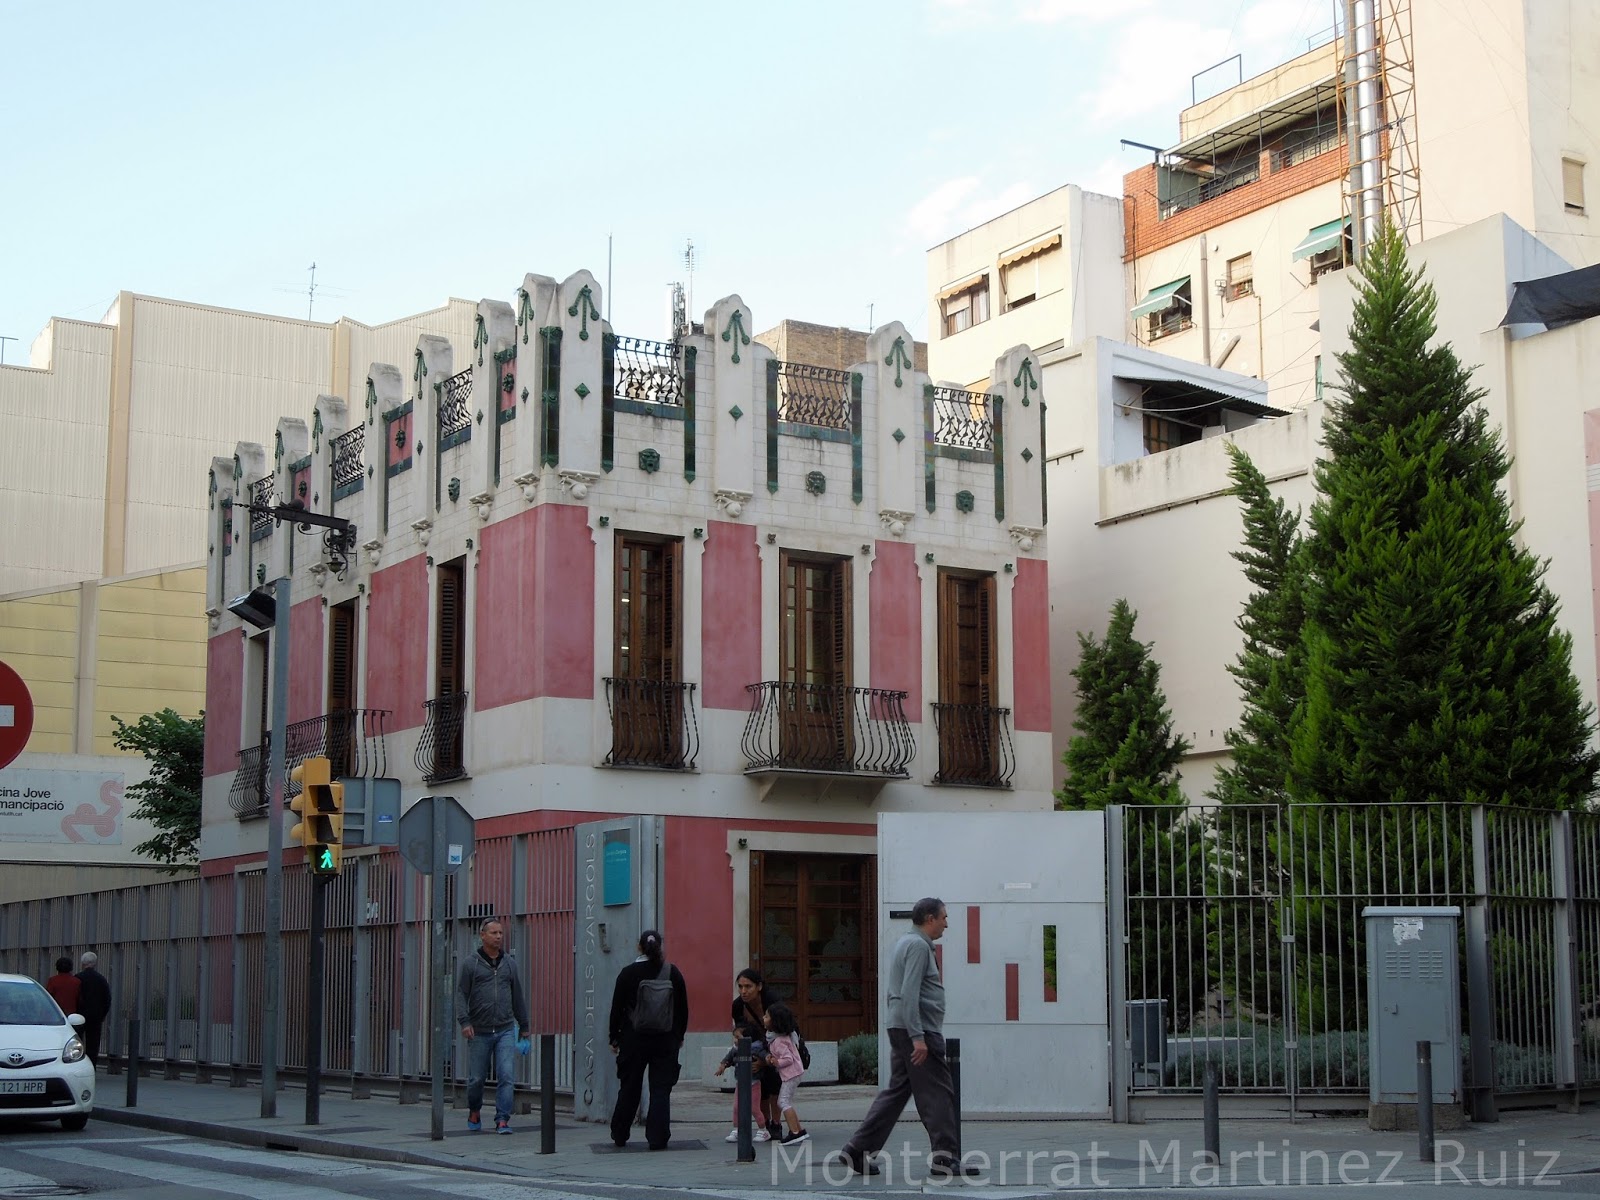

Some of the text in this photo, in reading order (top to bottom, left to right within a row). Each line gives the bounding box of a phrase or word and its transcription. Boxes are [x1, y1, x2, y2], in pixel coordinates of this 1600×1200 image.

[23, 787, 51, 798] Jove
[0, 799, 65, 812] mancipació
[583, 832, 596, 1106] CASA DELS CARGOLS
[24, 1082, 43, 1092] HPR
